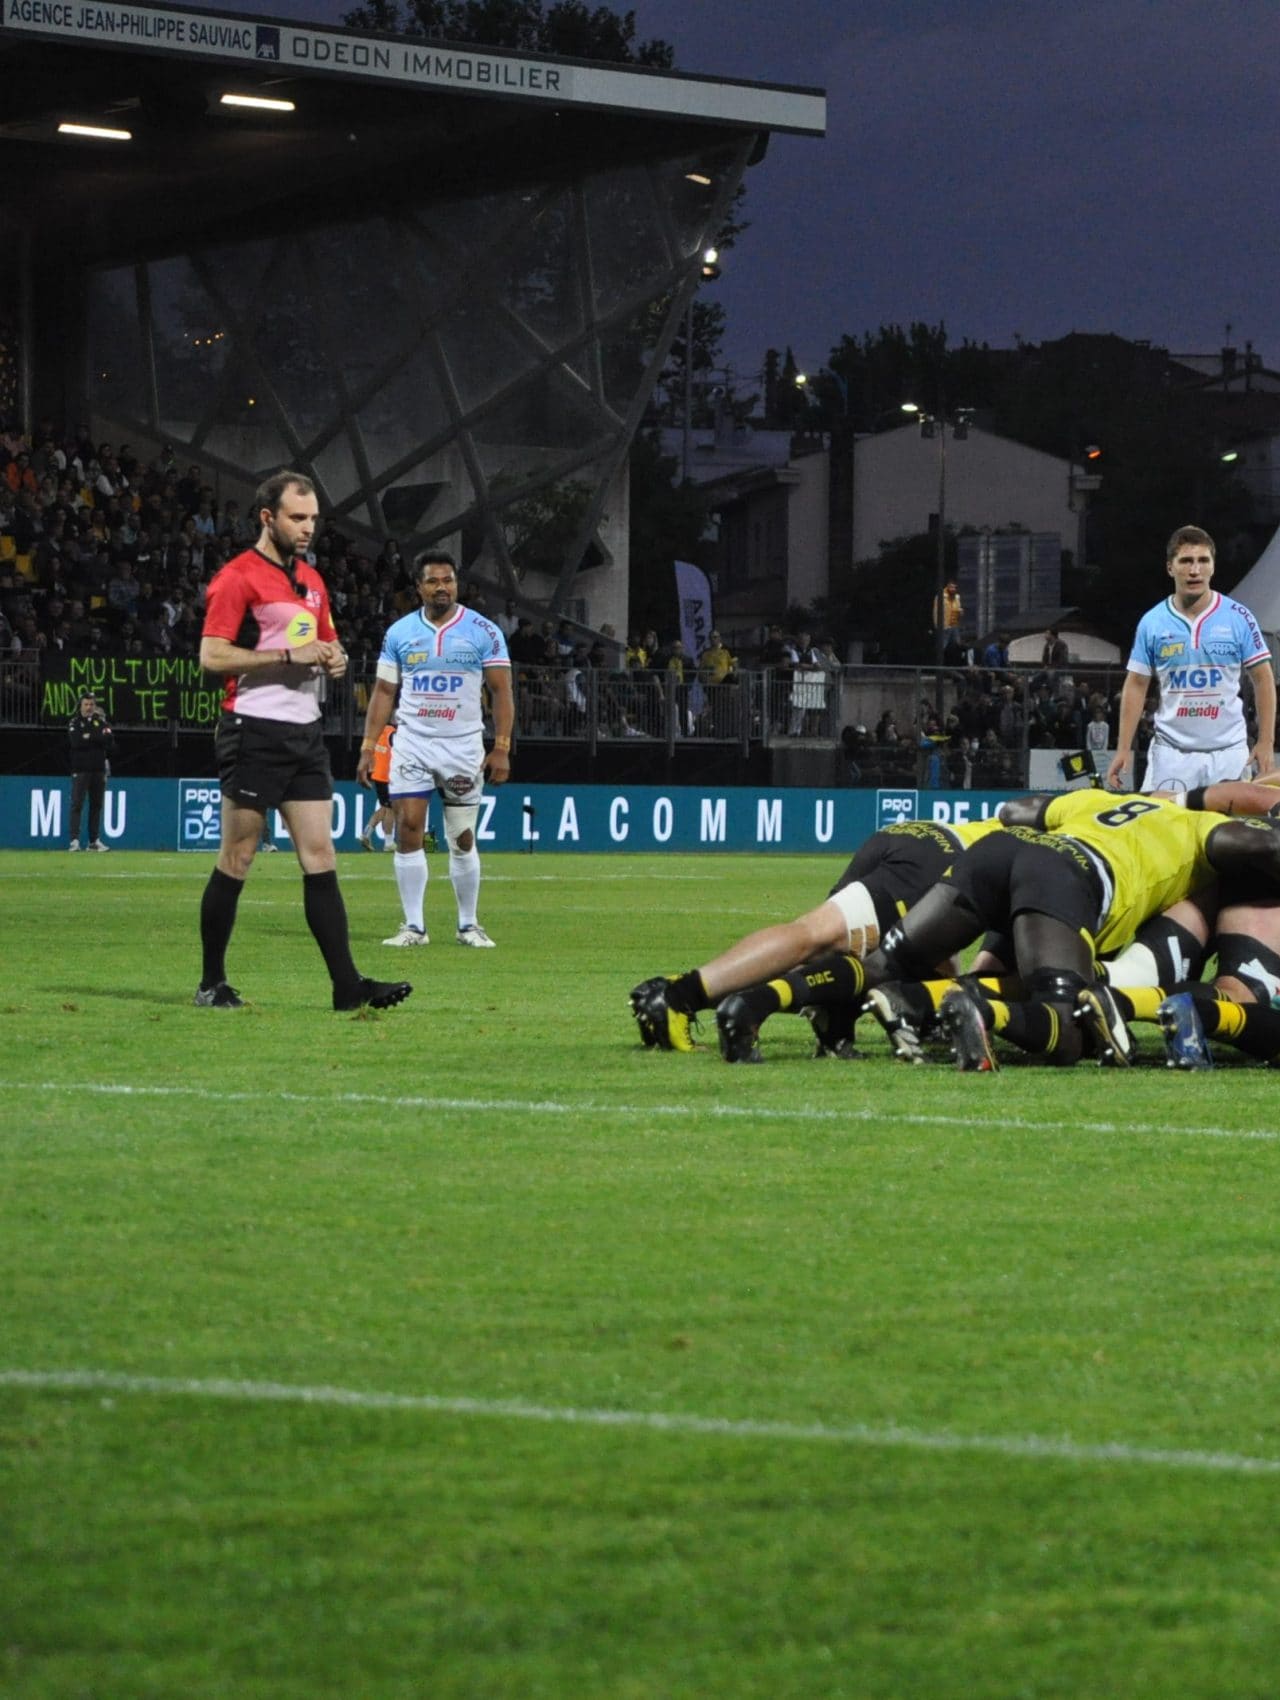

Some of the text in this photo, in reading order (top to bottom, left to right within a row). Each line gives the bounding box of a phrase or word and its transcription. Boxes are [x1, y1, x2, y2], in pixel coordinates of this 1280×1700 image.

[10, 0, 252, 50] AGENCE JEAN-PHILIPPE SAUVIAC
[292, 36, 560, 91] ODEON IMMOBILIER
[70, 656, 205, 688] MULTUMIM
[412, 675, 464, 693] MGP
[1169, 669, 1223, 689] MGP
[134, 690, 169, 720] TE
[417, 706, 456, 721] mendy
[1176, 703, 1220, 720] mendy
[881, 798, 912, 812] PRO
[1096, 799, 1162, 828] 8
